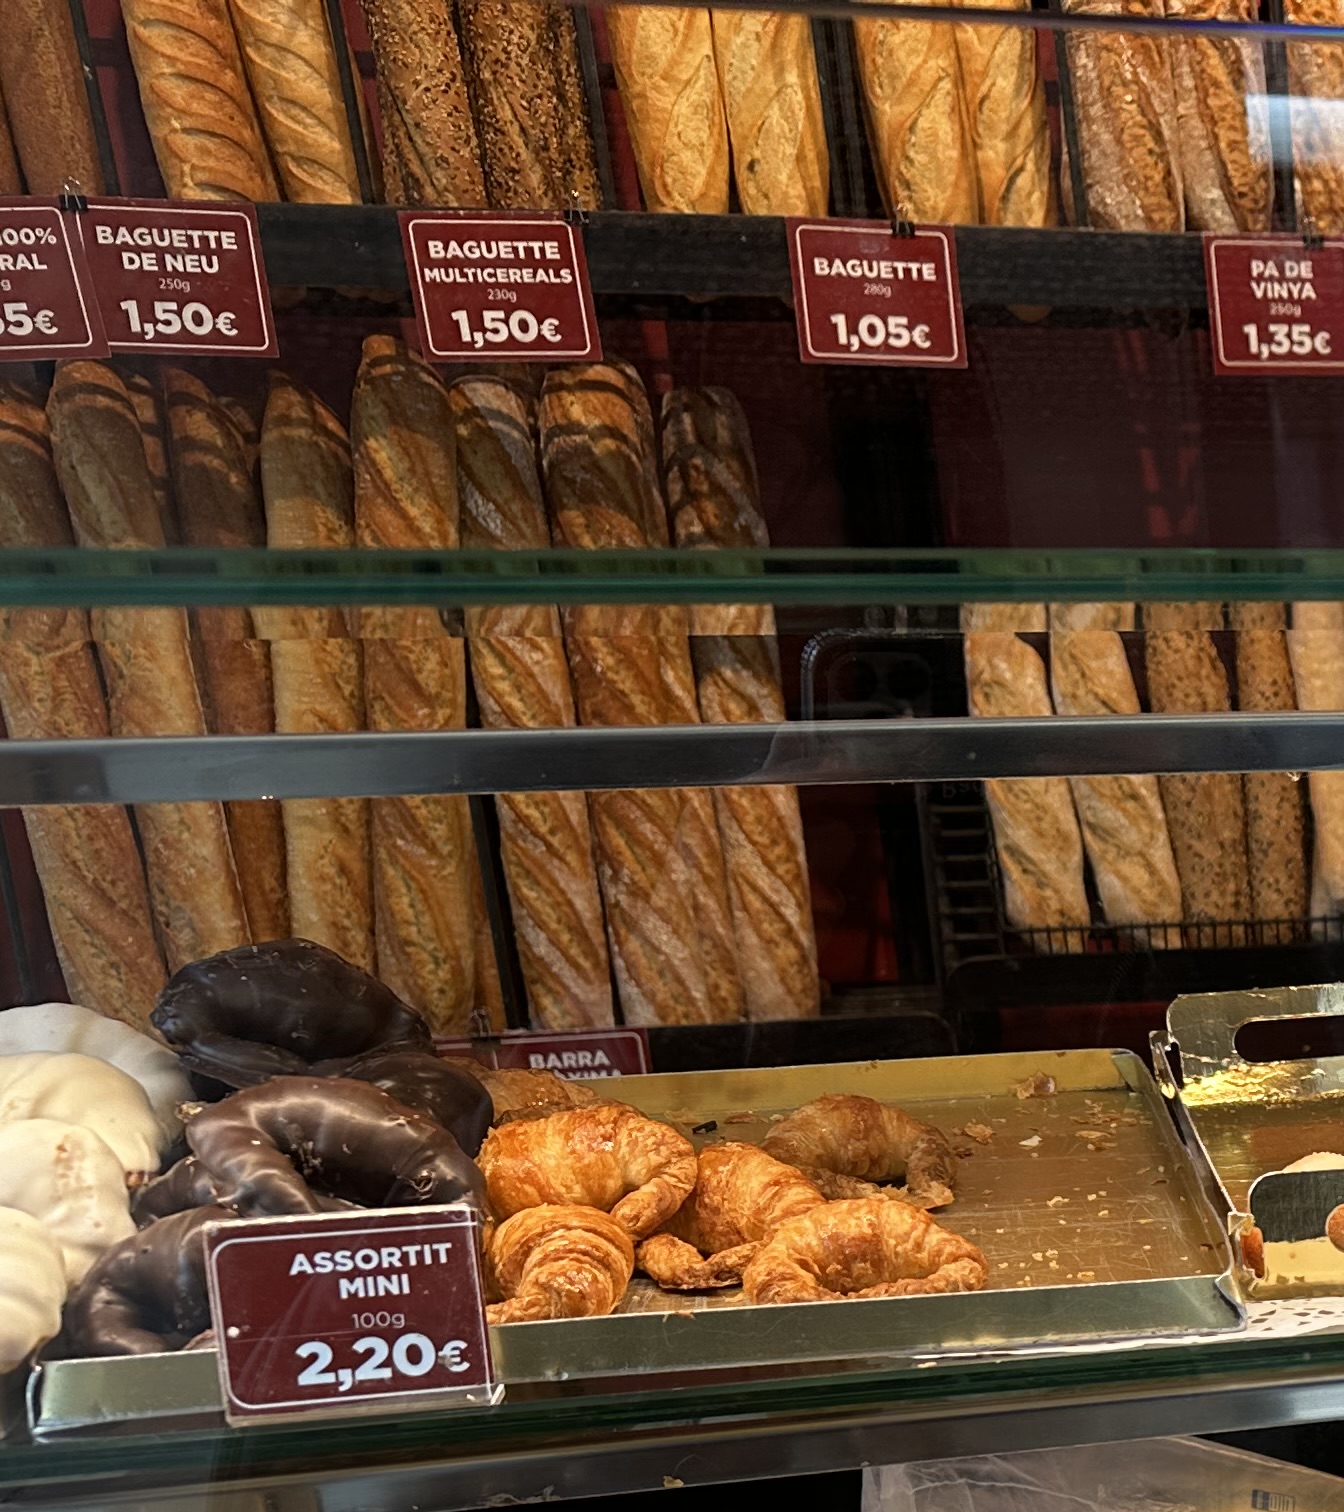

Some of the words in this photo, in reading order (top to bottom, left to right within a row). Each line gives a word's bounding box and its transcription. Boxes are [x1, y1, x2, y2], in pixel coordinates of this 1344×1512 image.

[0, 227, 57, 246] 00%
[95, 225, 238, 250] BAGUETTE
[427, 240, 561, 260] BAGUETTE
[121, 252, 158, 271] DE
[164, 253, 220, 274] NEU
[423, 267, 573, 284] MULTICEREALS
[813, 256, 937, 282] BAGUETTE
[1251, 259, 1279, 278] PA
[1284, 261, 1314, 279] DE
[158, 278, 191, 292] 250g
[1250, 281, 1318, 300] VINYA
[0, 302, 58, 336] 5€
[120, 300, 239, 341] 1,50€
[451, 309, 562, 348] 1,50€
[830, 313, 932, 352] 1,05€
[1242, 323, 1332, 359] 1,35€
[528, 1049, 612, 1069] BARRA
[289, 1242, 453, 1276] ASSORTIT
[339, 1273, 411, 1299] MINI
[351, 1310, 406, 1330] 100g
[295, 1332, 471, 1392] 2,20€
